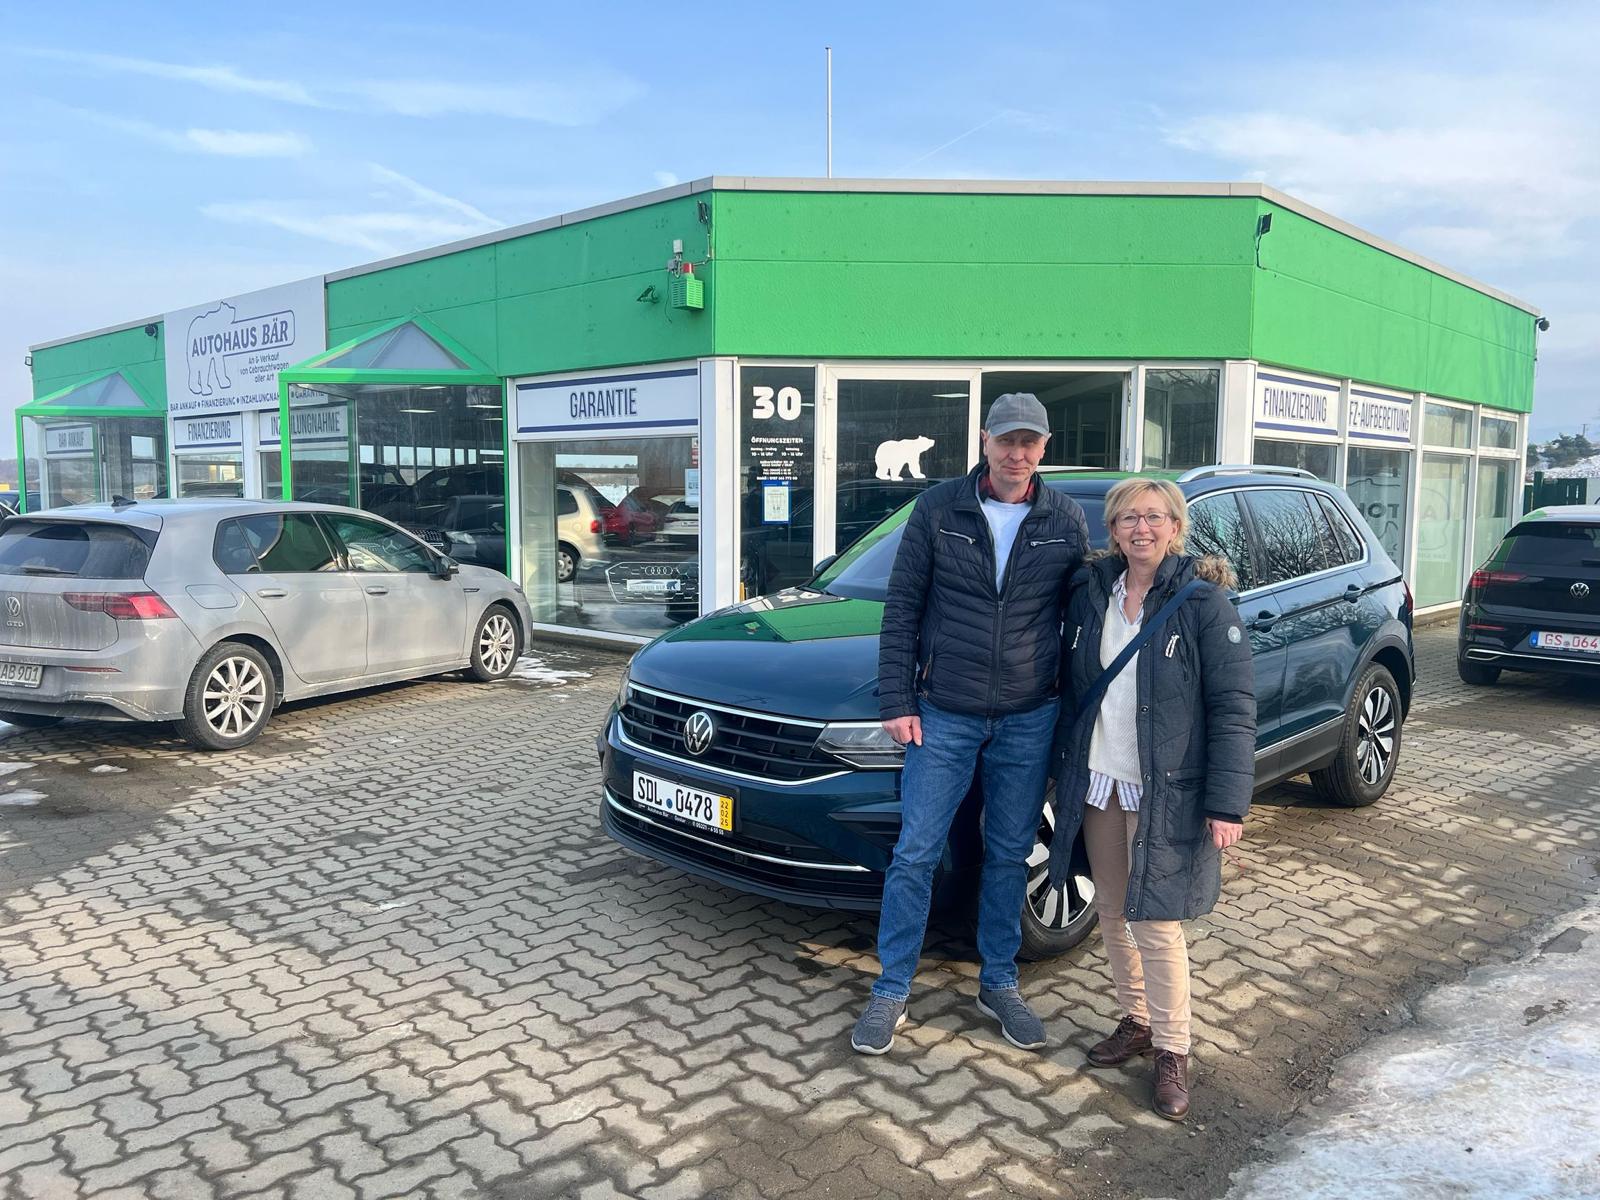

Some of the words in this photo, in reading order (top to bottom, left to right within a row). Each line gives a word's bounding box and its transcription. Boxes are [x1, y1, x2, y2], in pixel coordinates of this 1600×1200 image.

[192, 326, 257, 358] AUTOHAUS
[261, 317, 288, 345] BÄR
[260, 352, 279, 362] Verkauf
[249, 362, 289, 374] Gebrauchtwagen
[254, 374, 266, 382] aller
[266, 373, 275, 381] Art
[170, 402, 179, 411] BAR
[180, 401, 197, 410] ANKAUF
[201, 397, 236, 408] FINANZIERUNG
[570, 388, 637, 418] GARANTIE
[752, 386, 802, 421] 30
[1263, 387, 1327, 422] FINANZIERUNG
[1350, 401, 1410, 433] FZ-AUFBEREITUNG
[187, 420, 231, 441] FINANZIERUNG
[751, 436, 804, 444] ÖFFNUNGSZEITEN
[1544, 633, 1563, 646] GS
[1, 663, 17, 680] AB
[17, 665, 39, 682] 901
[637, 776, 663, 806] SDL
[675, 788, 713, 822] 0478
[720, 800, 729, 810] 22
[720, 810, 729, 818] 02
[720, 818, 729, 827] 25
